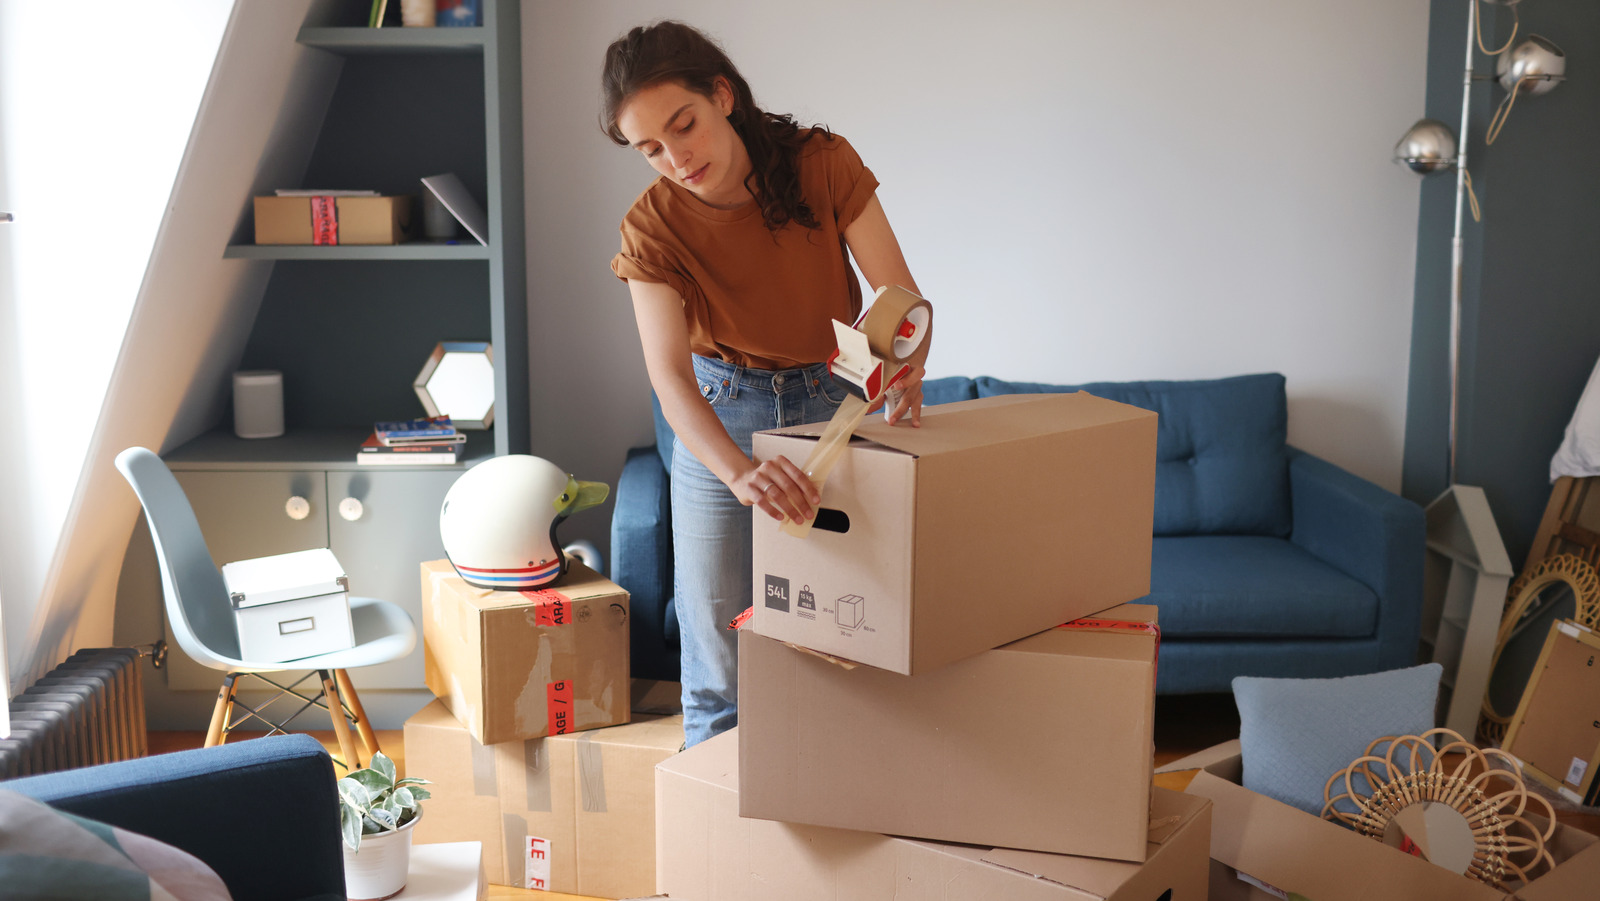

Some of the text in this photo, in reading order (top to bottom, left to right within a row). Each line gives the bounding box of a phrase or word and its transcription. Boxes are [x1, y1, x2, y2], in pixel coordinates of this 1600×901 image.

[767, 584, 787, 600] 54L
[553, 600, 564, 624] ARA
[556, 711, 567, 735] AGE
[531, 838, 545, 891] LE F
